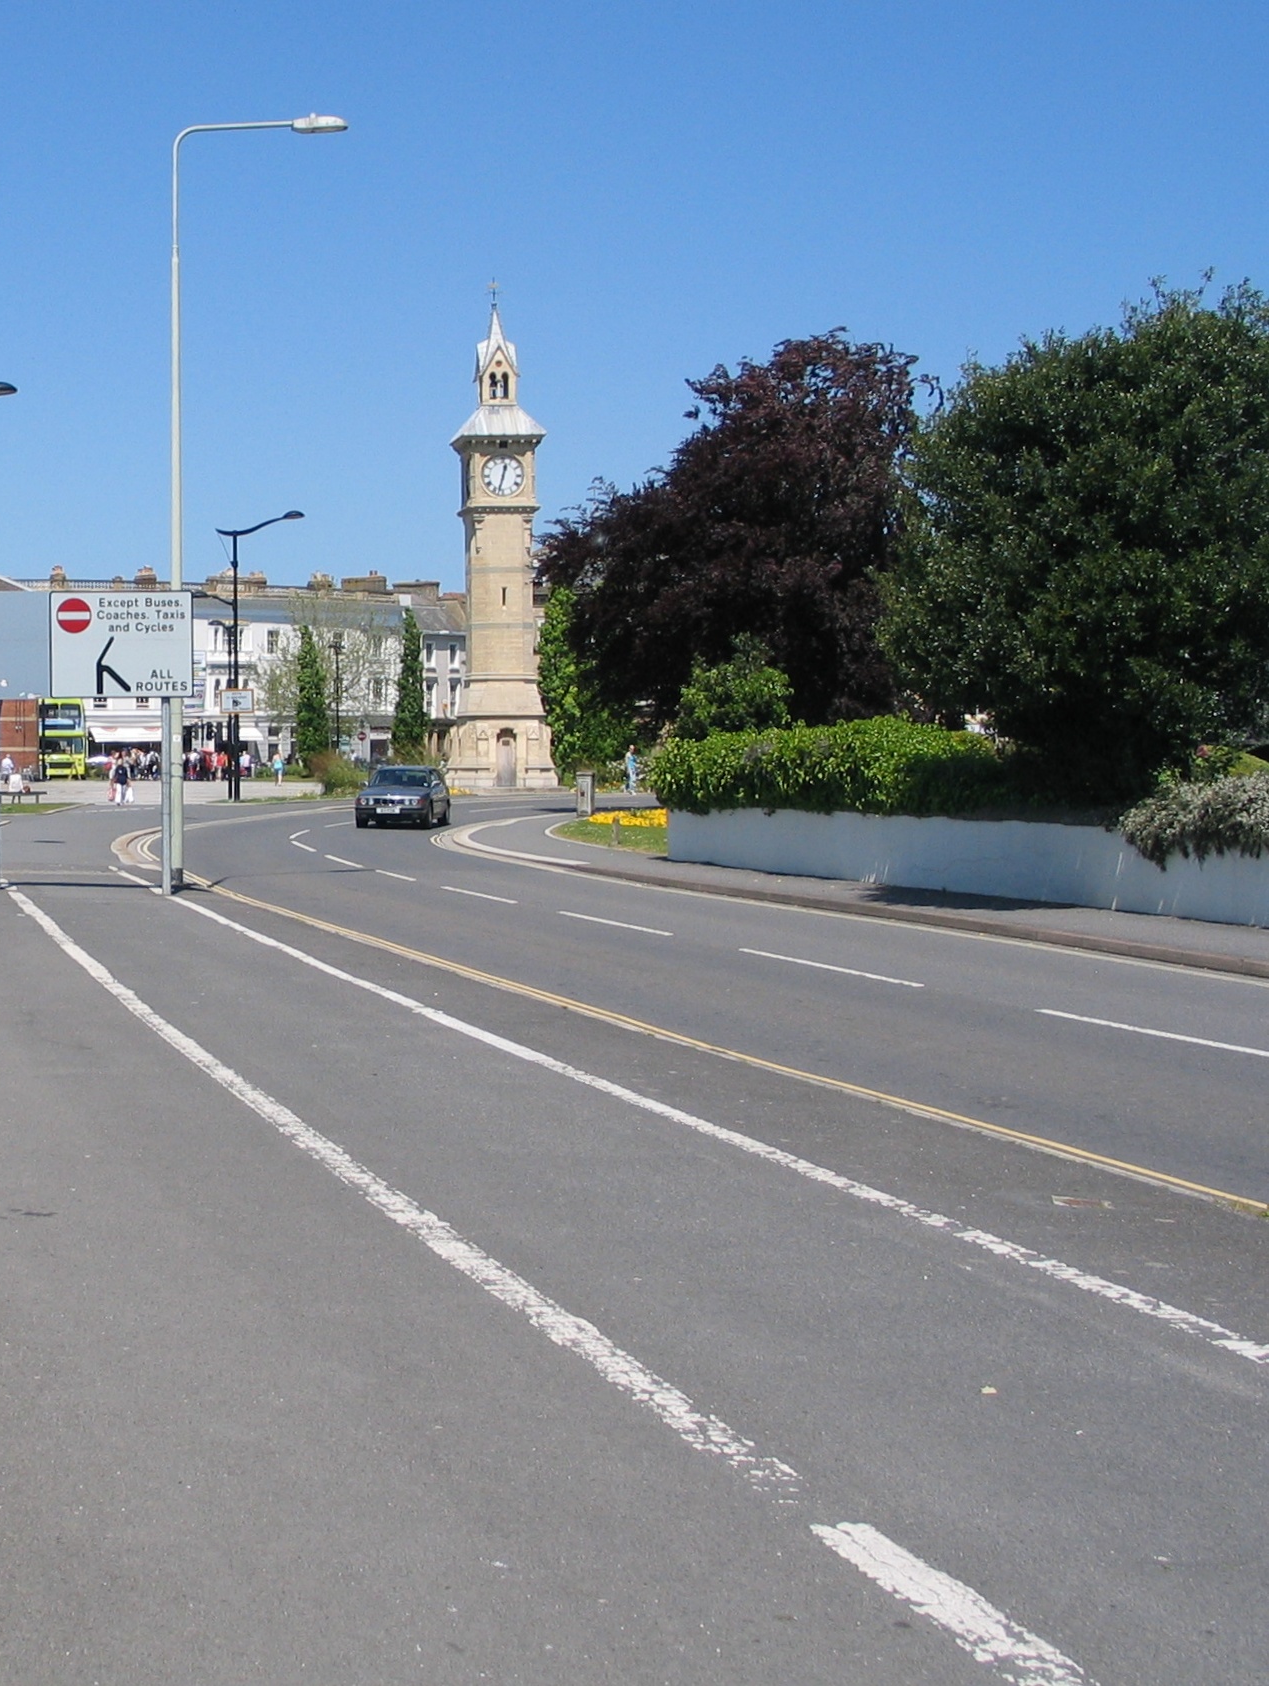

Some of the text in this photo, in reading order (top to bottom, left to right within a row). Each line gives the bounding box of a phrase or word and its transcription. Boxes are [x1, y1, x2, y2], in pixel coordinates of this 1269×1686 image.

[98, 598, 139, 608] Except
[155, 610, 186, 620] Taxis
[108, 622, 174, 633] and Cycles
[151, 669, 173, 679] ALL
[136, 682, 188, 691] ROUTES
